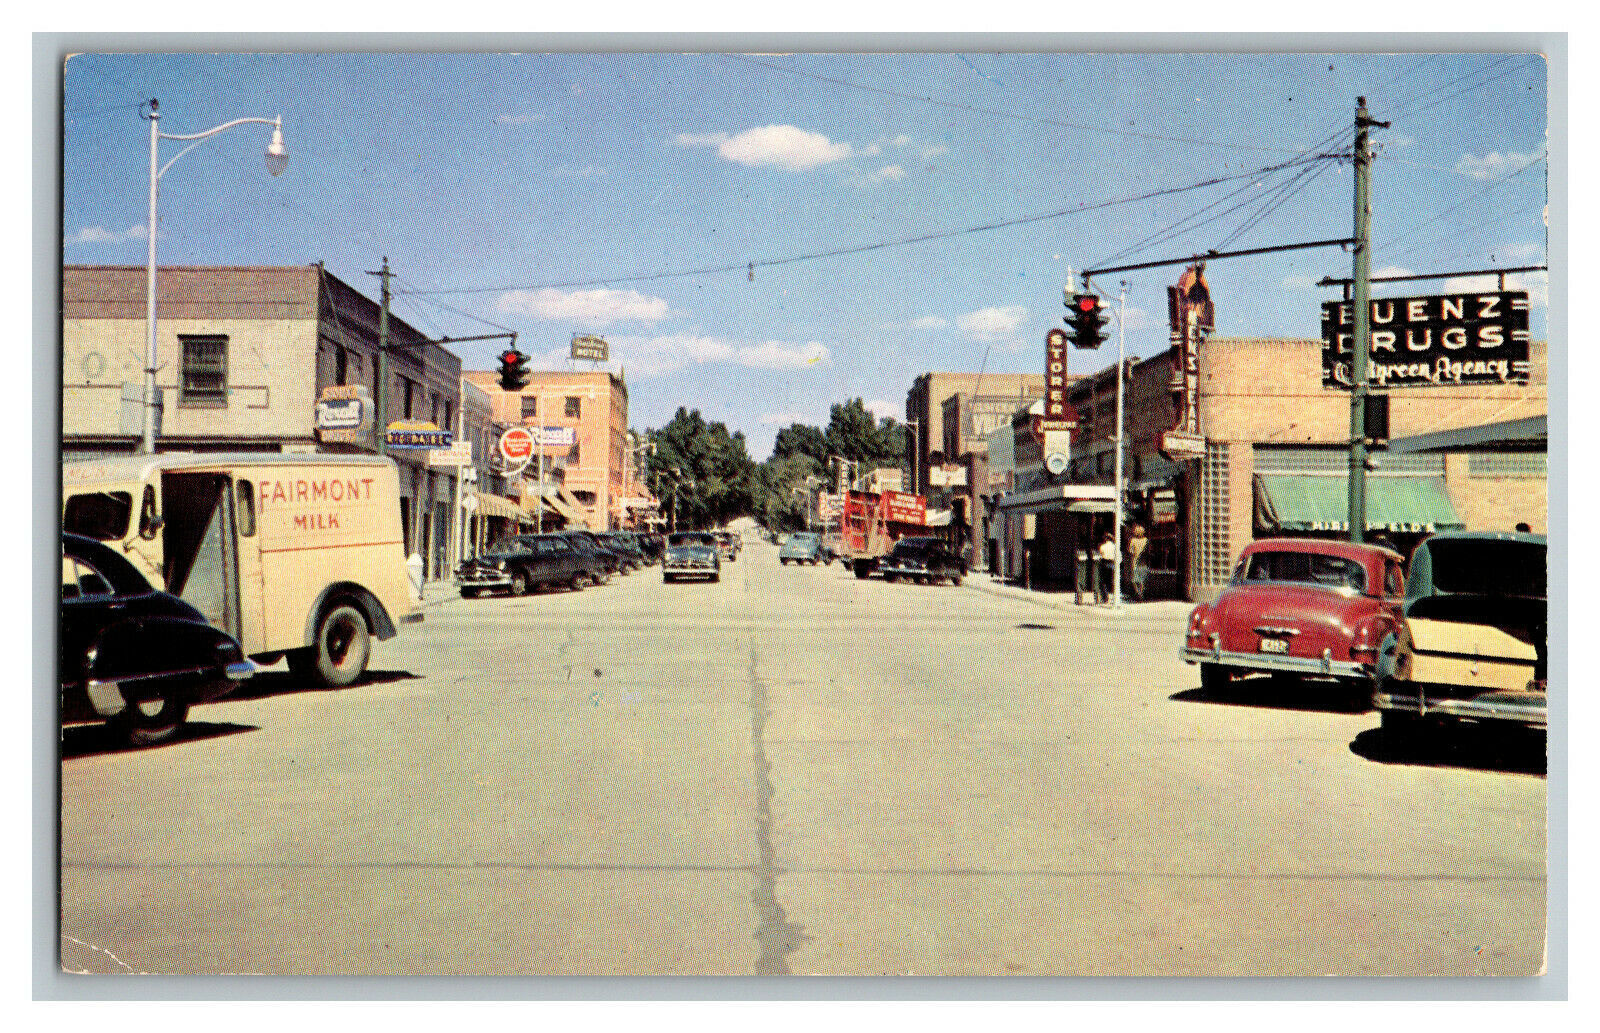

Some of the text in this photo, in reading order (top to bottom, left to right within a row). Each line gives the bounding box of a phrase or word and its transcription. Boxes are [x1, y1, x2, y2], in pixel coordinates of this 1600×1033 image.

[1431, 355, 1509, 382] Agency
[259, 478, 374, 515] FAIRMONT
[294, 513, 339, 530] MILK
